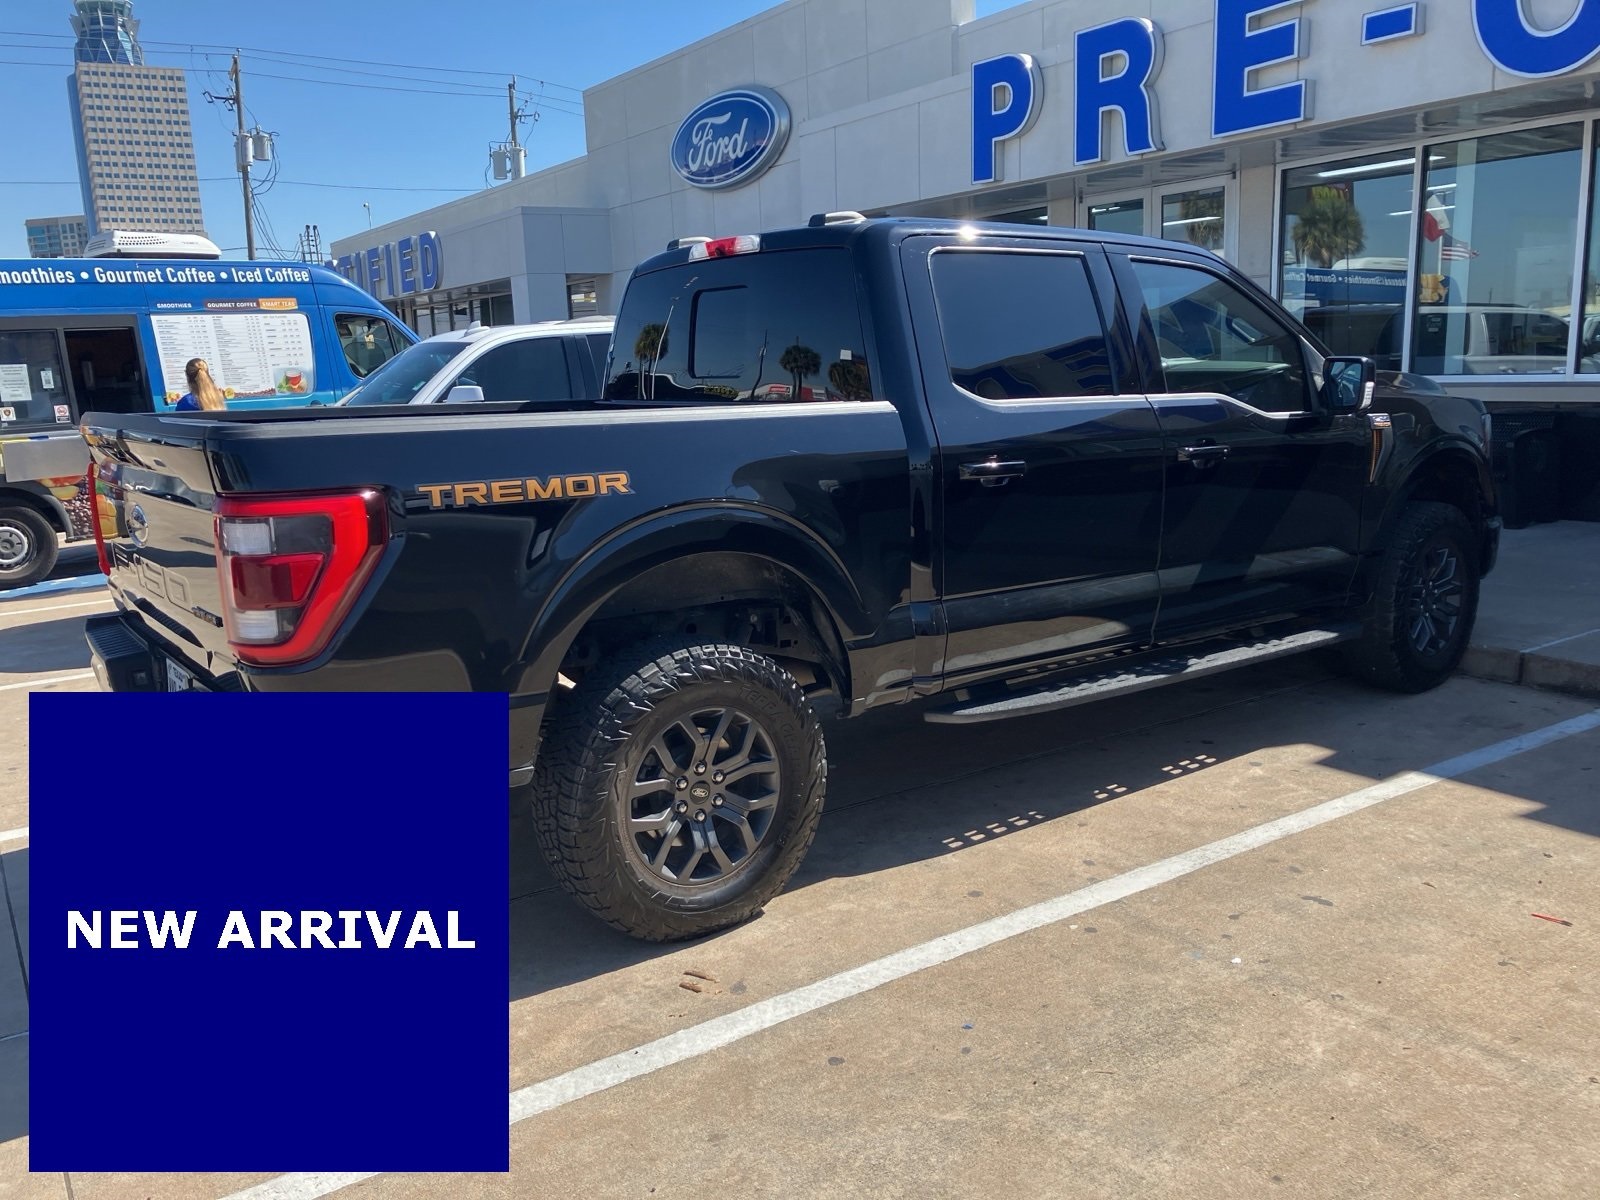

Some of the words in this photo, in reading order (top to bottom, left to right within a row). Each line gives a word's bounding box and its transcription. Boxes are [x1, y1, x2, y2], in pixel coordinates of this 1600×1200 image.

[688, 111, 749, 172] Ford
[94, 267, 162, 283] Gourmet
[166, 267, 216, 283] Coffee
[232, 267, 263, 283] Iced
[266, 267, 310, 282] Coffee
[325, 231, 443, 298] TIFIED
[416, 472, 632, 509] TREMOR
